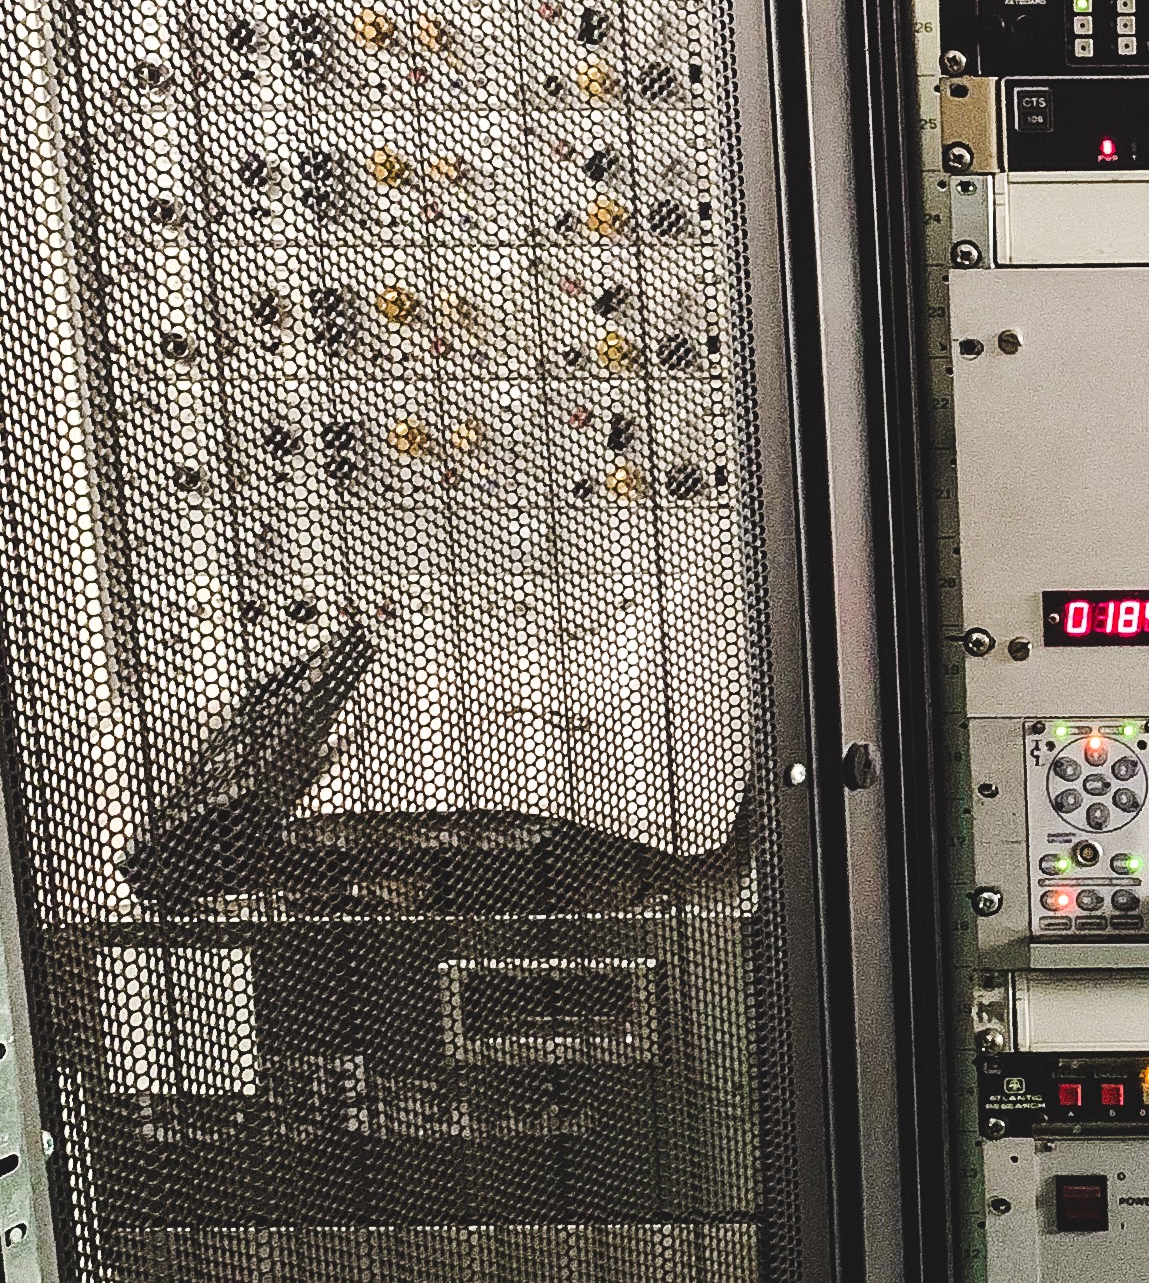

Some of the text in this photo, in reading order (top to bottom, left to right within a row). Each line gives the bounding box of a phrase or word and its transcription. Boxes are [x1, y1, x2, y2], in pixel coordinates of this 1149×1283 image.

[915, 22, 933, 34] 26
[1022, 97, 1047, 107] CTS
[920, 119, 938, 130] 25
